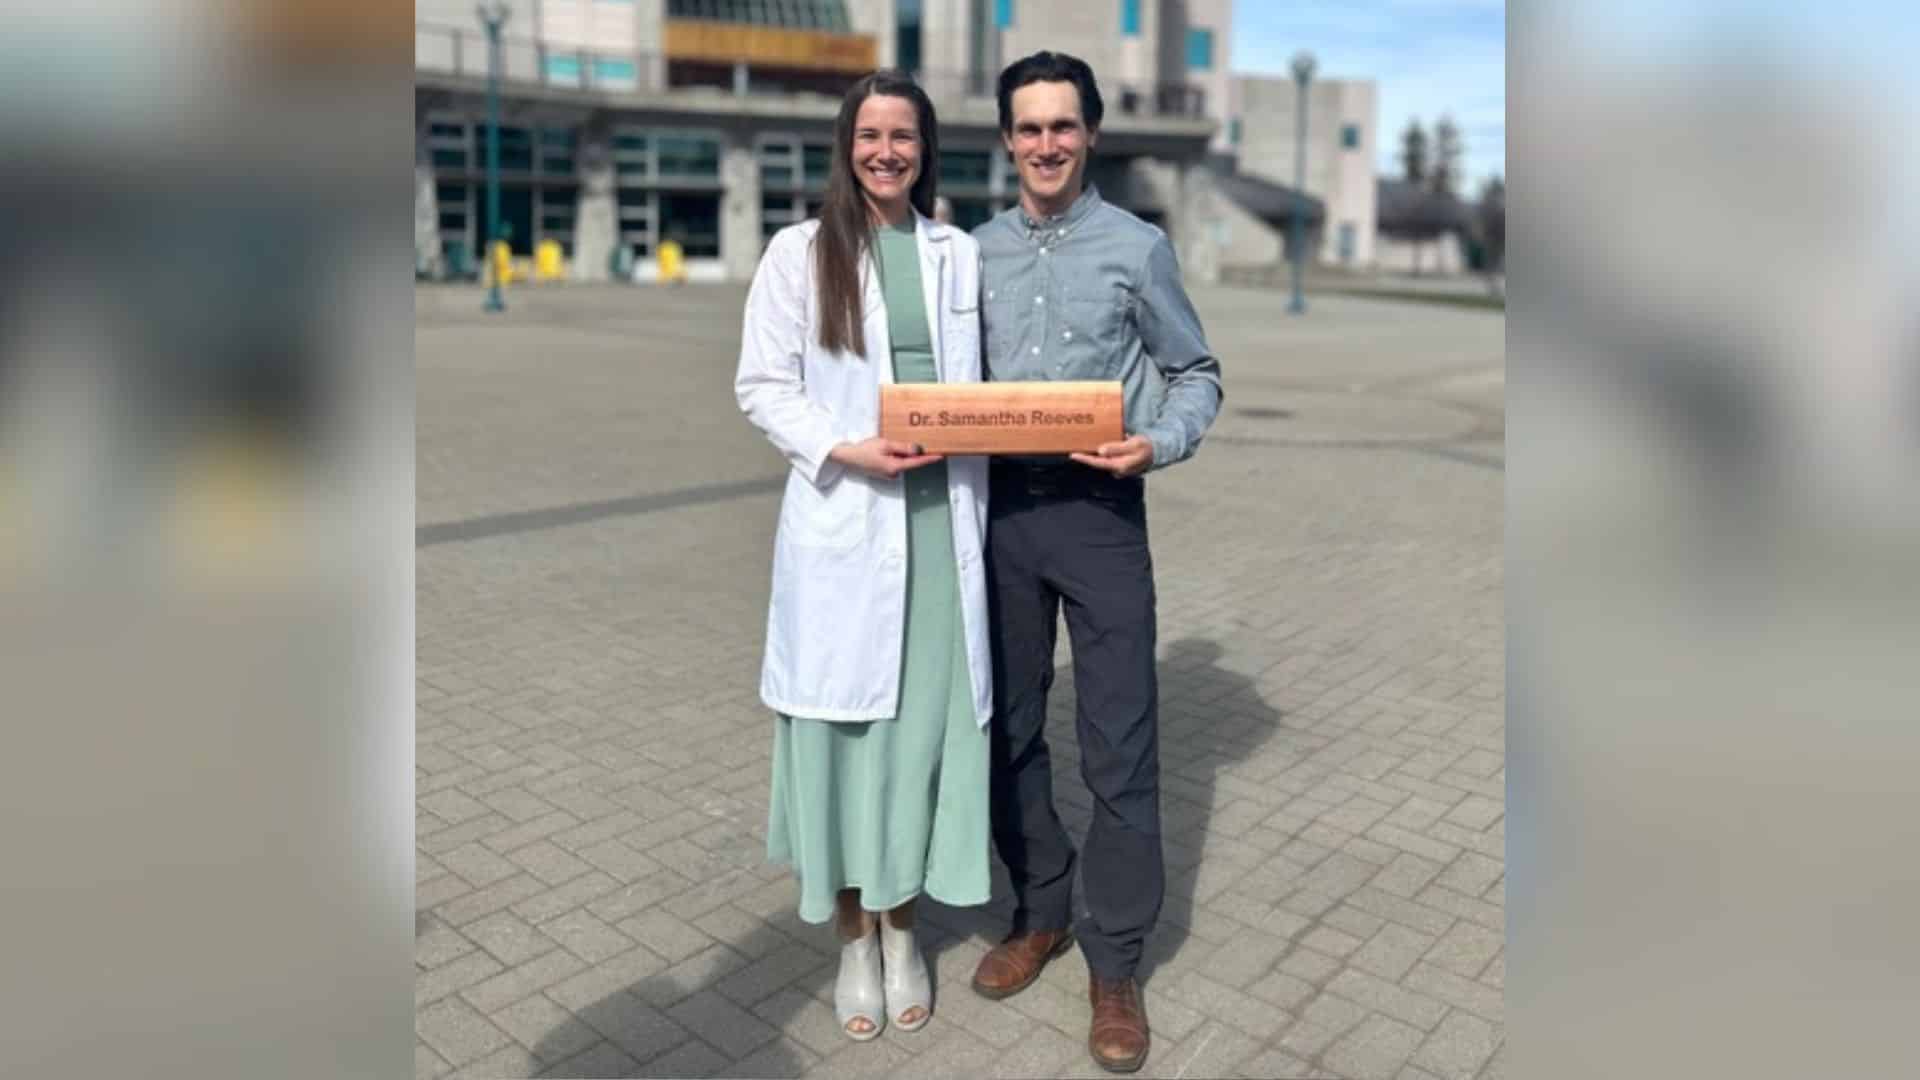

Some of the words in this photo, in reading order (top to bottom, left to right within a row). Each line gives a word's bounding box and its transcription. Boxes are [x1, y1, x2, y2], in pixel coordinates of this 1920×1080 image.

[909, 411, 934, 427] Dr.
[939, 411, 1026, 426] Samantha
[1031, 410, 1094, 425] Reeves
